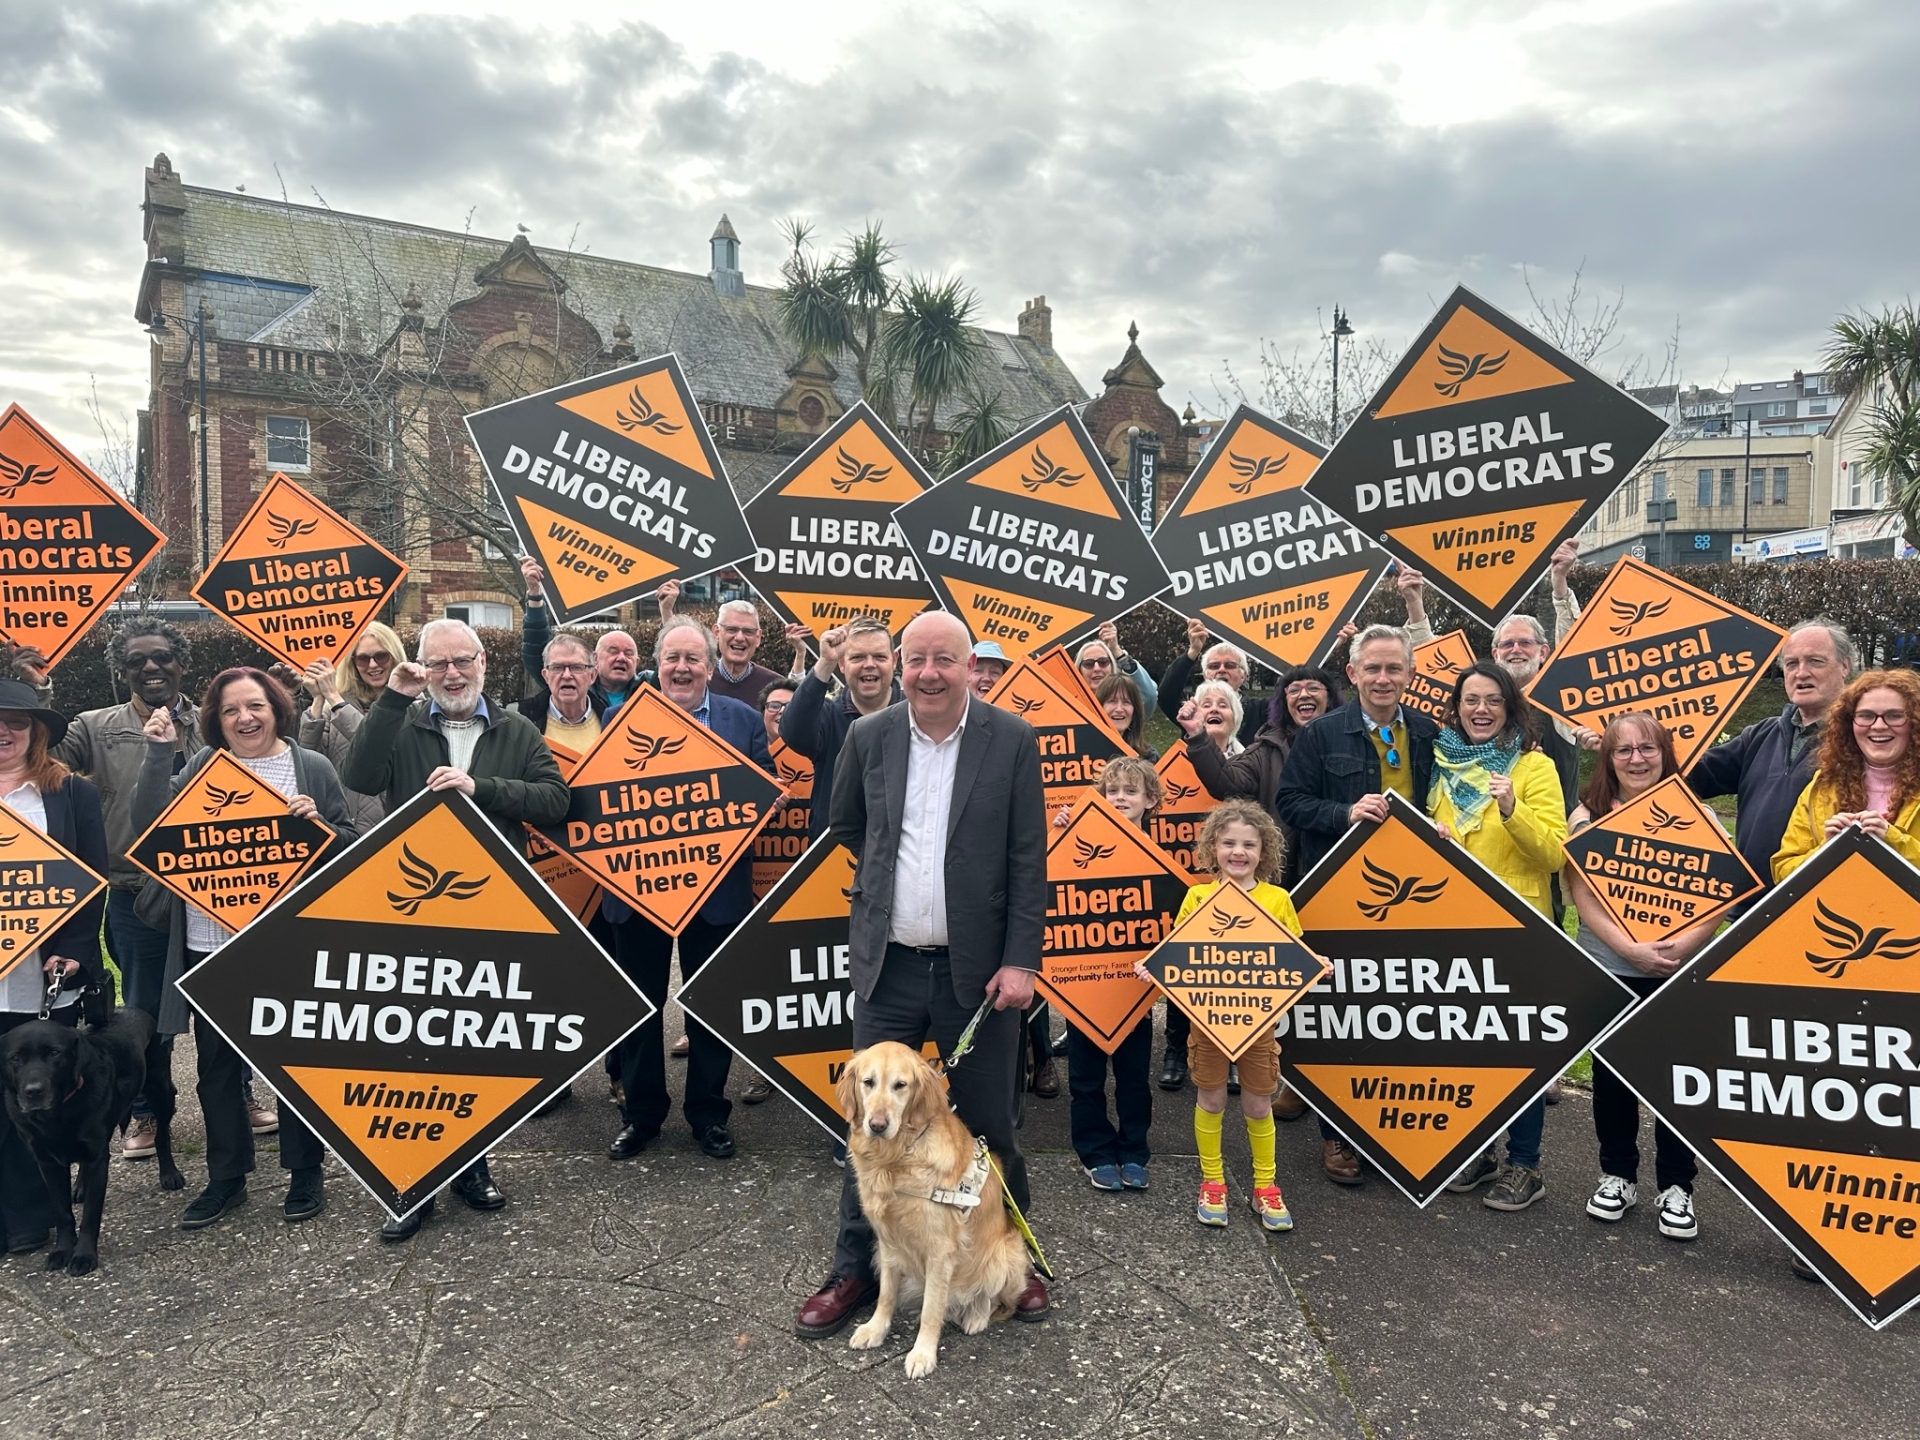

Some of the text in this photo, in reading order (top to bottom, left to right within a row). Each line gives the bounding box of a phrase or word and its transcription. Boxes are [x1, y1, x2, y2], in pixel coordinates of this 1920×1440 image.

[1392, 411, 1564, 469] LIBERAL
[552, 430, 690, 515] LIBERAL
[1140, 453, 1153, 522] PALACE
[1354, 442, 1615, 514] DEMOCRATS
[501, 444, 717, 559] DEMOCRATS
[0, 511, 93, 541] beral
[790, 516, 910, 548] LIBERA
[968, 505, 1099, 562] LIBERAL
[1199, 504, 1344, 556] LIBERAL
[1432, 519, 1537, 552] Winning
[1793, 535, 1823, 545] insurance
[547, 521, 637, 576] Winning
[754, 547, 929, 582] DEMOCRA
[926, 529, 1129, 601] DEMOCRATS
[1171, 528, 1379, 597] DEMOCRAT
[1456, 548, 1515, 572] Here
[1771, 546, 1788, 555] direct
[249, 552, 350, 586] Liberal
[556, 549, 610, 584] Here
[0, 580, 94, 607] inning
[224, 575, 383, 612] Democrats
[1241, 591, 1330, 624] Winning
[3, 607, 69, 628] here
[258, 610, 355, 635] Winning
[972, 593, 1054, 632] Winning
[1265, 616, 1315, 640] Here
[284, 631, 337, 653] here
[981, 617, 1030, 643] Here
[1588, 628, 1712, 680] Liberal
[1560, 651, 1756, 712] Democrats
[1041, 755, 1107, 782] crats
[600, 773, 721, 816] Liberal
[183, 820, 280, 848] Liberal
[567, 801, 758, 848] Democrats
[157, 839, 309, 872] Democrats
[605, 842, 722, 874] Winning
[1614, 837, 1710, 874] Liberal
[187, 870, 280, 892] Winning
[635, 869, 698, 896] here
[1584, 850, 1733, 898] Democrats
[0, 886, 77, 907] crats
[211, 891, 261, 909] here
[1607, 881, 1696, 918] Winning
[1042, 911, 1173, 951] emocrat
[1622, 903, 1672, 928] here
[1050, 966, 1077, 974] Stronger
[1189, 945, 1276, 965] Liberal
[313, 950, 533, 1001] LIBERAL
[1051, 973, 1102, 984] Opportunity
[1117, 970, 1140, 979] Every
[1164, 965, 1303, 986] Democrats
[1188, 992, 1273, 1012] Winning
[1207, 1010, 1254, 1026] here
[249, 997, 586, 1052] DEMOCRATS
[1734, 1015, 1920, 1071] LIBER
[343, 1082, 478, 1118] Winning
[1350, 1076, 1475, 1107] Winning
[1672, 1064, 1920, 1130] DEMOC
[367, 1115, 445, 1141] Here
[1378, 1107, 1449, 1131] Here
[1786, 1161, 1920, 1204] Winnin
[1821, 1201, 1917, 1238] Here
